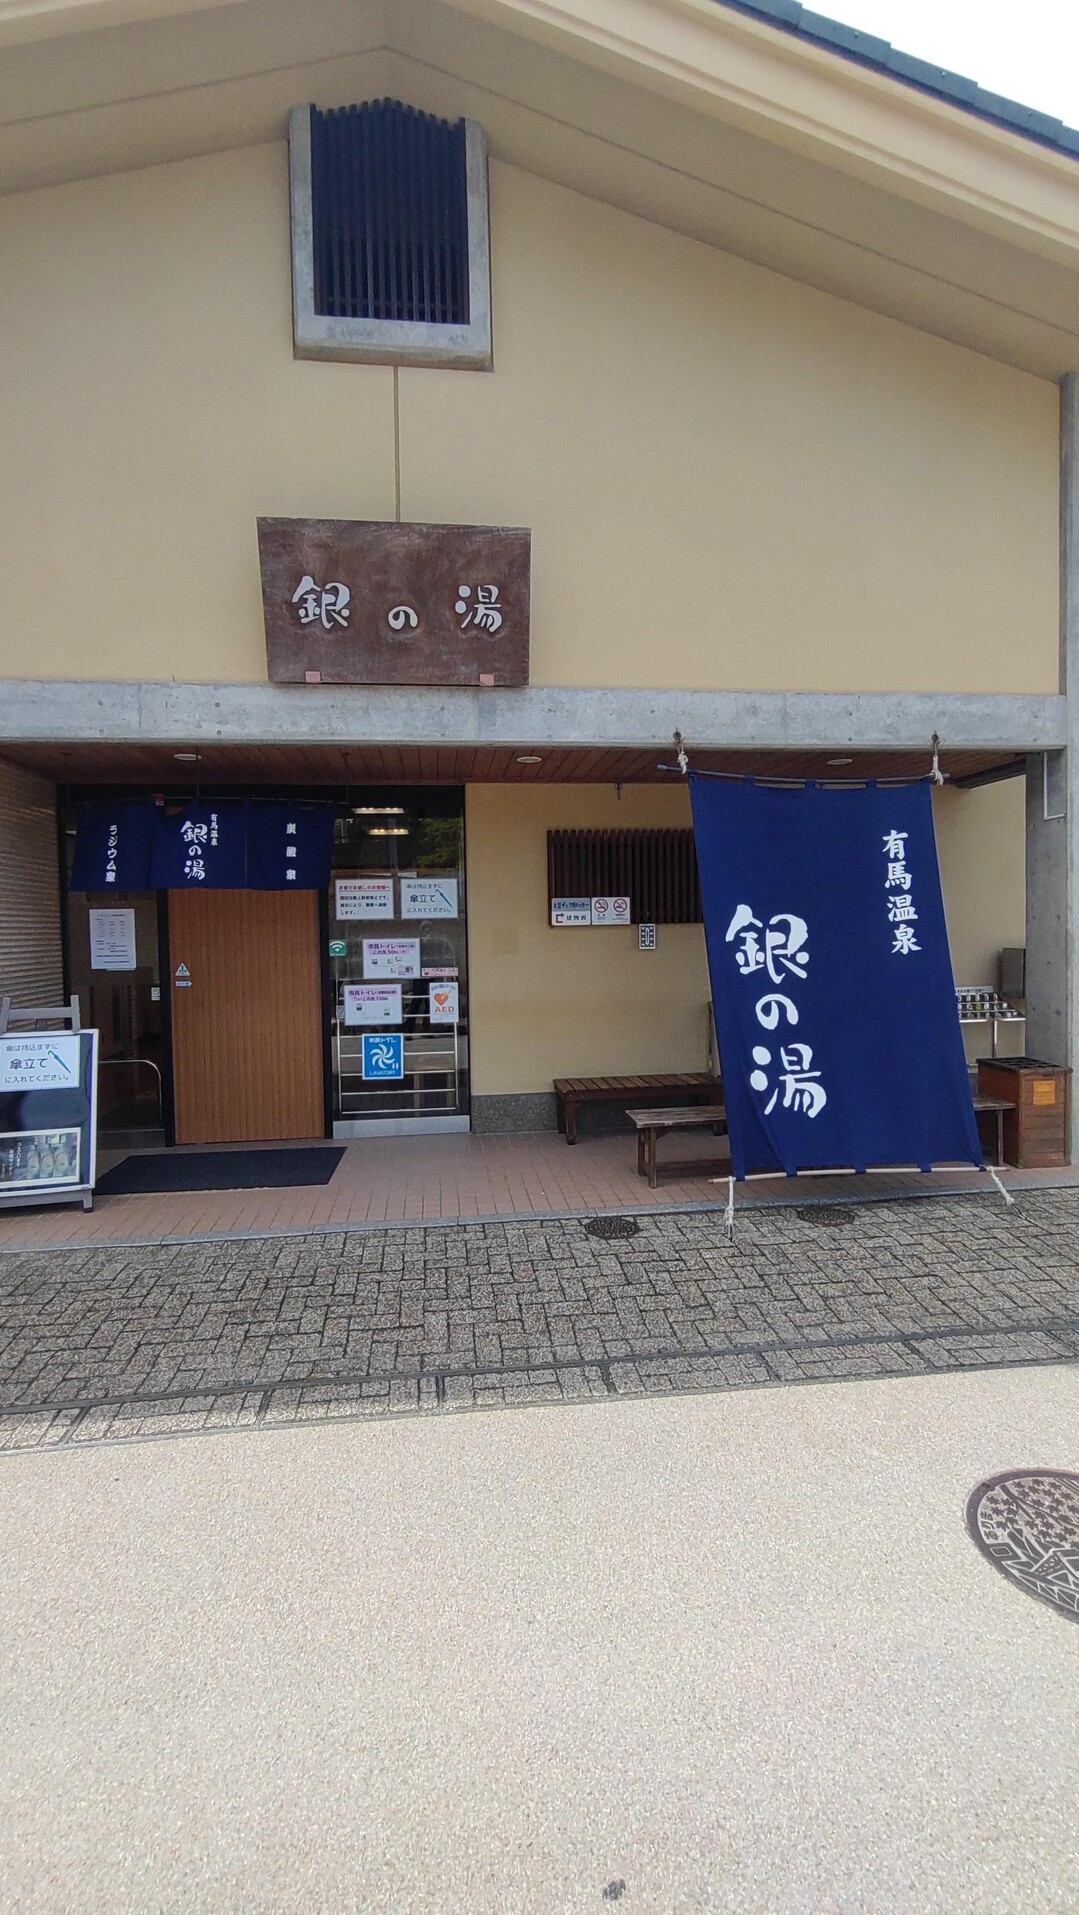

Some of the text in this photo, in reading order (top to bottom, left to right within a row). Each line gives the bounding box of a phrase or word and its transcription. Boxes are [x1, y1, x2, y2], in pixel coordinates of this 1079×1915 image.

[292, 575, 503, 633] 銀の湯
[105, 824, 118, 883] ラジウム泉
[180, 820, 208, 881] 銀の湯
[210, 813, 219, 846] 有馬温泉
[286, 822, 297, 881] 炭酸泉
[410, 894, 436, 903] 傘立て
[882, 829, 922, 955] 有馬温泉
[725, 903, 828, 1118] 銀の湯
[6, 1043, 59, 1052] 傘は持込まずに
[9, 1057, 49, 1070] 傘立て
[4, 1072, 70, 1084] に入れてください。
